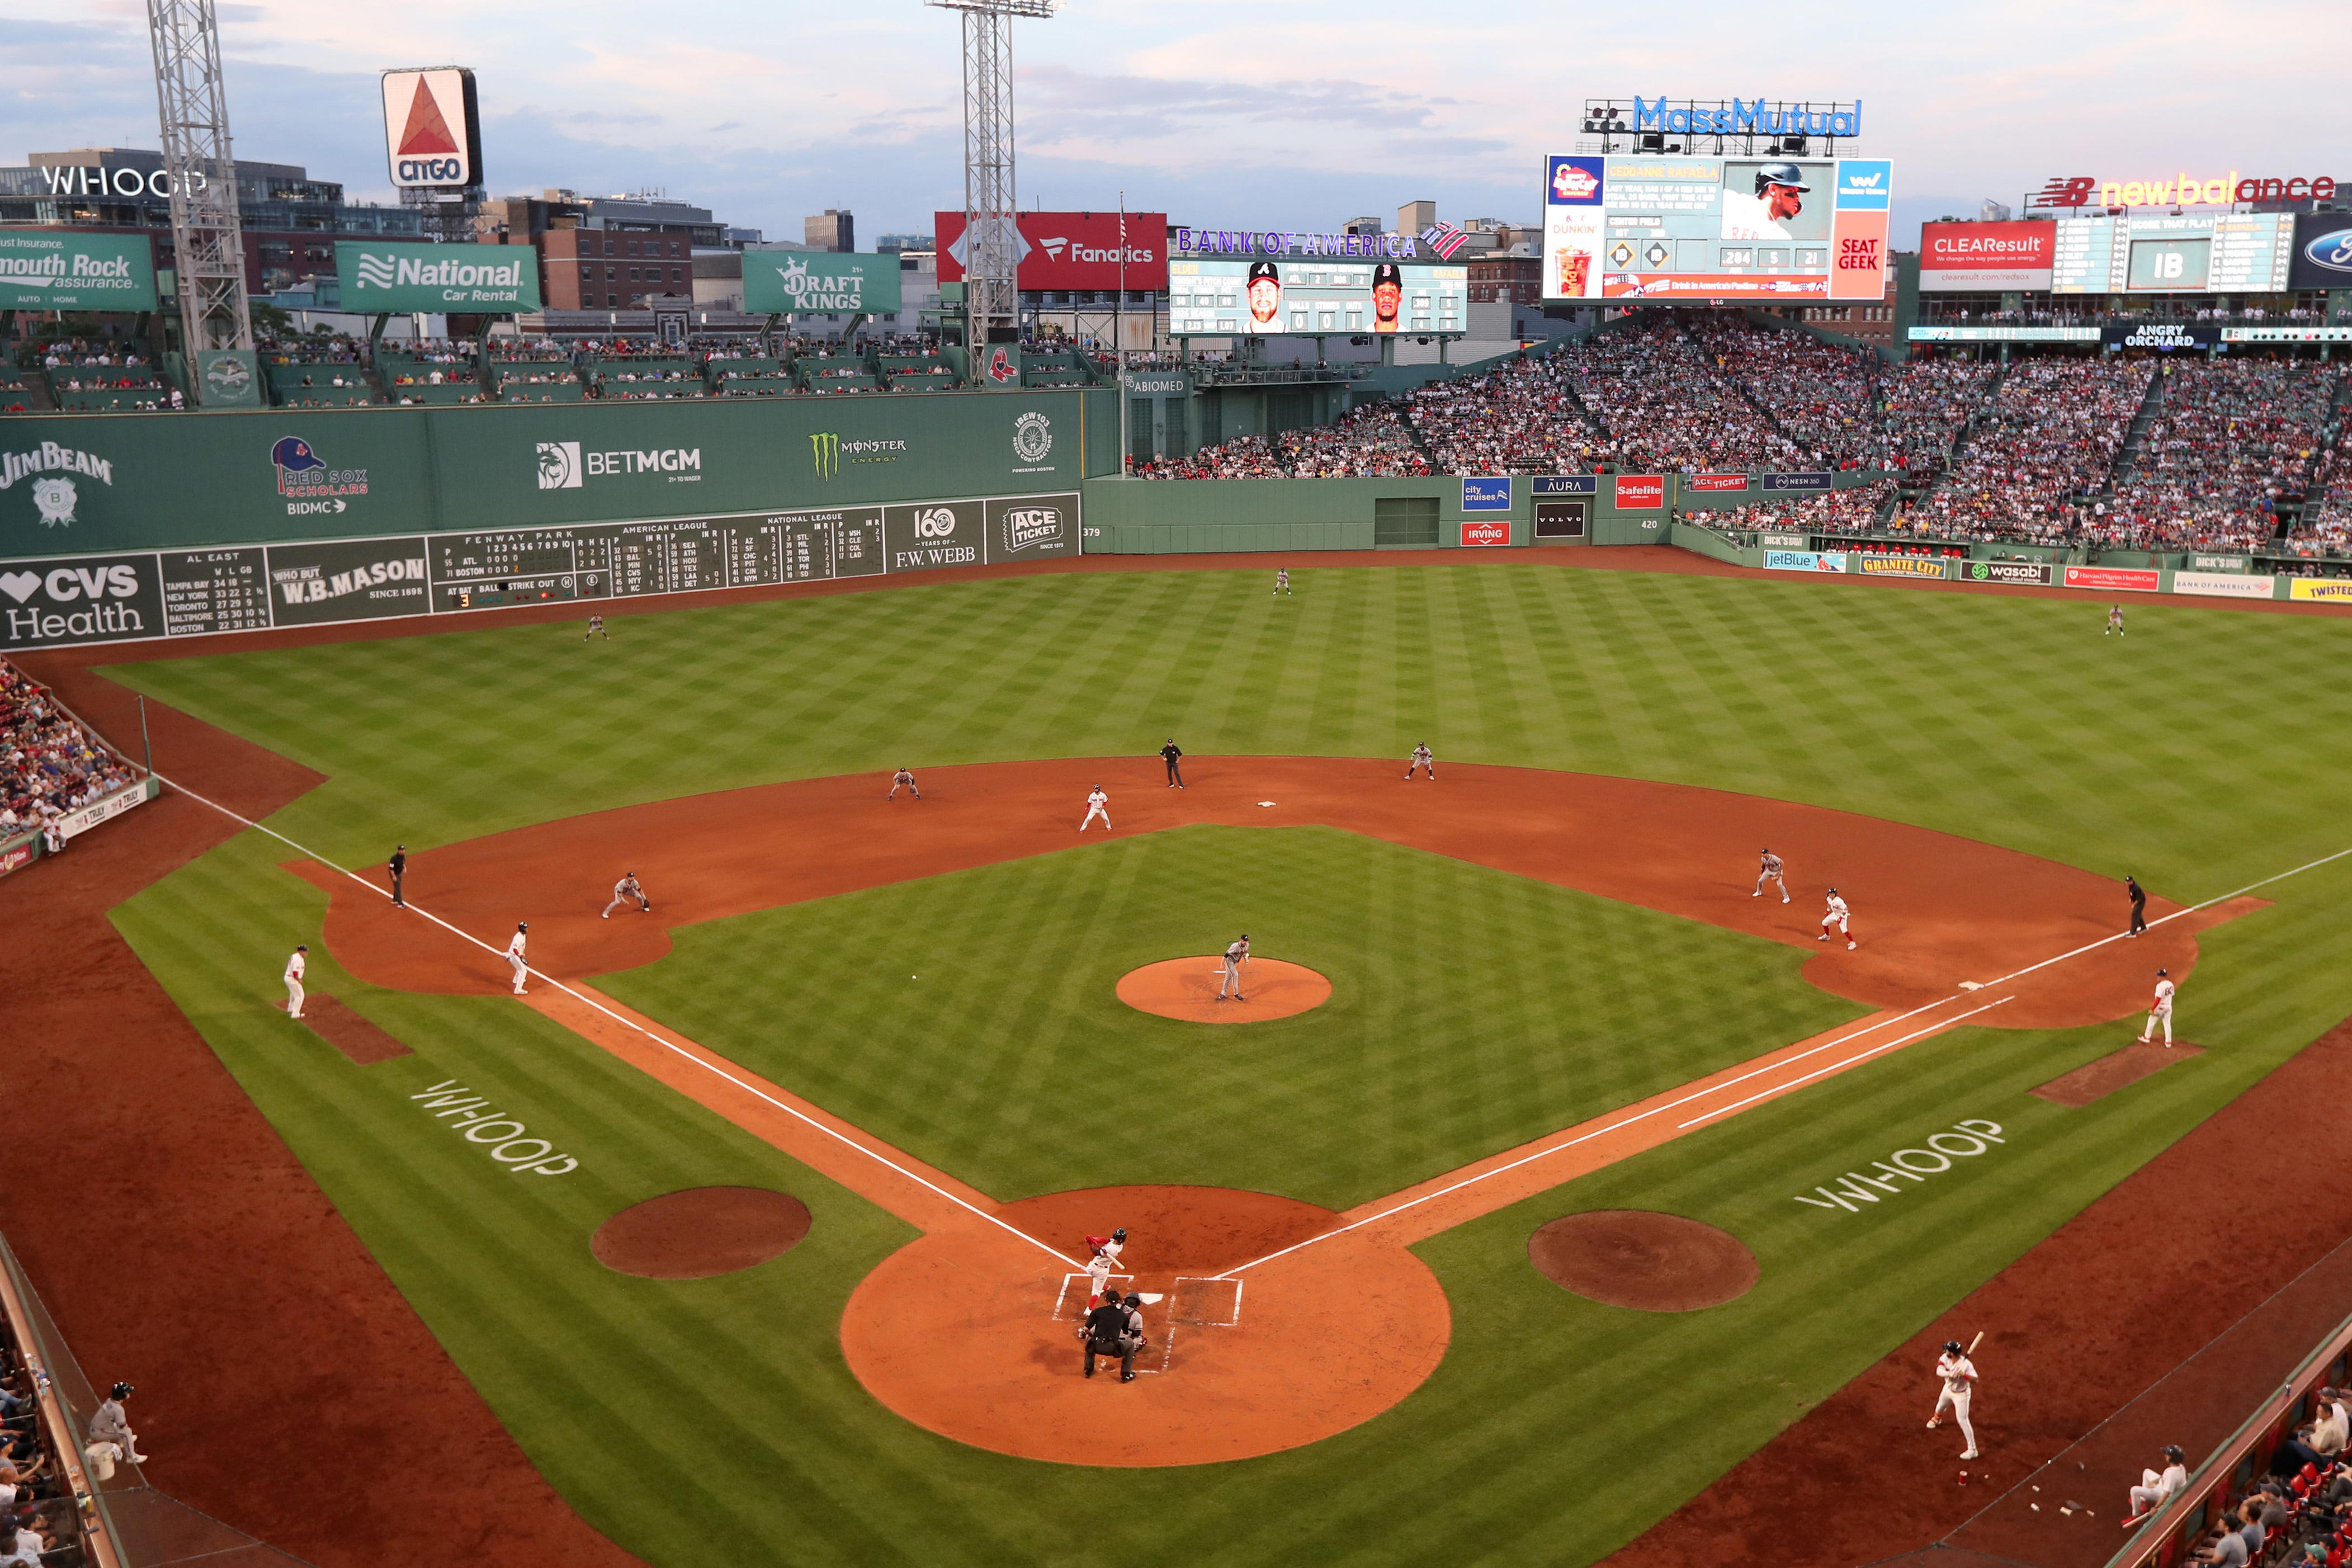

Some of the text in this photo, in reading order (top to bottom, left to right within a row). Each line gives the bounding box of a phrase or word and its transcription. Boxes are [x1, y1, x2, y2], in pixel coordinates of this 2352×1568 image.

[1633, 96, 1862, 136] MassMutual
[399, 158, 461, 181] CITGO
[1609, 166, 1718, 178] CEDDANNE RAFAELA
[41, 166, 207, 199] WHOOP
[2162, 219, 2186, 229] THAT
[2188, 219, 2214, 228] PLAY
[0, 238, 64, 249] ust Insurance.
[1179, 228, 1417, 258] BANK OF AMERICA
[1841, 239, 1878, 253] SEAT
[1934, 236, 2041, 252] CLEAResult
[73, 254, 130, 277] Rock
[1839, 255, 1878, 270] GEEK
[396, 258, 521, 286] National
[1172, 264, 1199, 275] ELDER
[1433, 269, 1466, 278] RAFAELA
[55, 278, 133, 289] assurance
[783, 274, 863, 296] DRAFT
[1672, 281, 1690, 290] Drink
[1691, 281, 1698, 290] in
[1699, 281, 1731, 290] America's
[443, 290, 517, 301] Car Rental
[794, 292, 862, 310] KINGS
[1289, 301, 1310, 310] BALLS
[1315, 301, 1340, 310] STRIKES
[2136, 325, 2185, 336] ANGRY
[2125, 336, 2194, 347] ORCHARD
[1134, 380, 1183, 392] ABIOMED
[1015, 412, 1050, 428] IBEW 103
[842, 440, 906, 454] MONSTER
[1013, 437, 1021, 455] NECA
[1021, 435, 1052, 462] CONTRACTORS
[588, 448, 701, 475] BETMGM
[286, 470, 367, 485] RED SOX
[1694, 478, 1746, 488] ACE TICKET
[286, 484, 368, 497] SCHOLARS
[1465, 486, 1481, 494] city
[1617, 486, 1661, 495] Safelite
[287, 501, 331, 515] BIDMC
[914, 508, 956, 539] 160
[1015, 509, 1056, 530] ACE
[623, 522, 707, 534] AMERICAN LEAGUE
[1016, 526, 1056, 542] TICKET
[1083, 528, 1100, 537] 379
[1468, 529, 1503, 539] IRVING
[465, 530, 573, 545] FENWAY PARK
[1764, 536, 1788, 545] DICK'S
[208, 552, 239, 561] EAST
[463, 558, 477, 566] ATL
[896, 546, 975, 568] F.W. WEBB
[1769, 552, 1810, 566] jetBlue
[2195, 556, 2225, 568] DICK'S
[456, 567, 484, 577] BOSTON
[1863, 559, 1943, 576] GRANITE CITY
[1990, 566, 2041, 578] wasabi
[273, 568, 320, 582] WHO BUT
[45, 564, 138, 602] CVS
[166, 580, 209, 591] TAMPA BAY
[448, 579, 555, 596] AT BAT BALL STRIKE OUT
[168, 592, 209, 602] NEW YORK
[369, 588, 423, 599] SINCE 1898
[2311, 586, 2352, 598] TWISTED
[168, 602, 208, 612] TORONTO
[6, 601, 144, 640] Health
[169, 613, 214, 623] BALTIMORE
[171, 624, 204, 634] BOSTON
[124, 791, 139, 803] TRULY
[89, 806, 105, 819] TRULY
[410, 1079, 578, 1175] WHOOP
[1793, 1119, 2006, 1212] WHOOP
